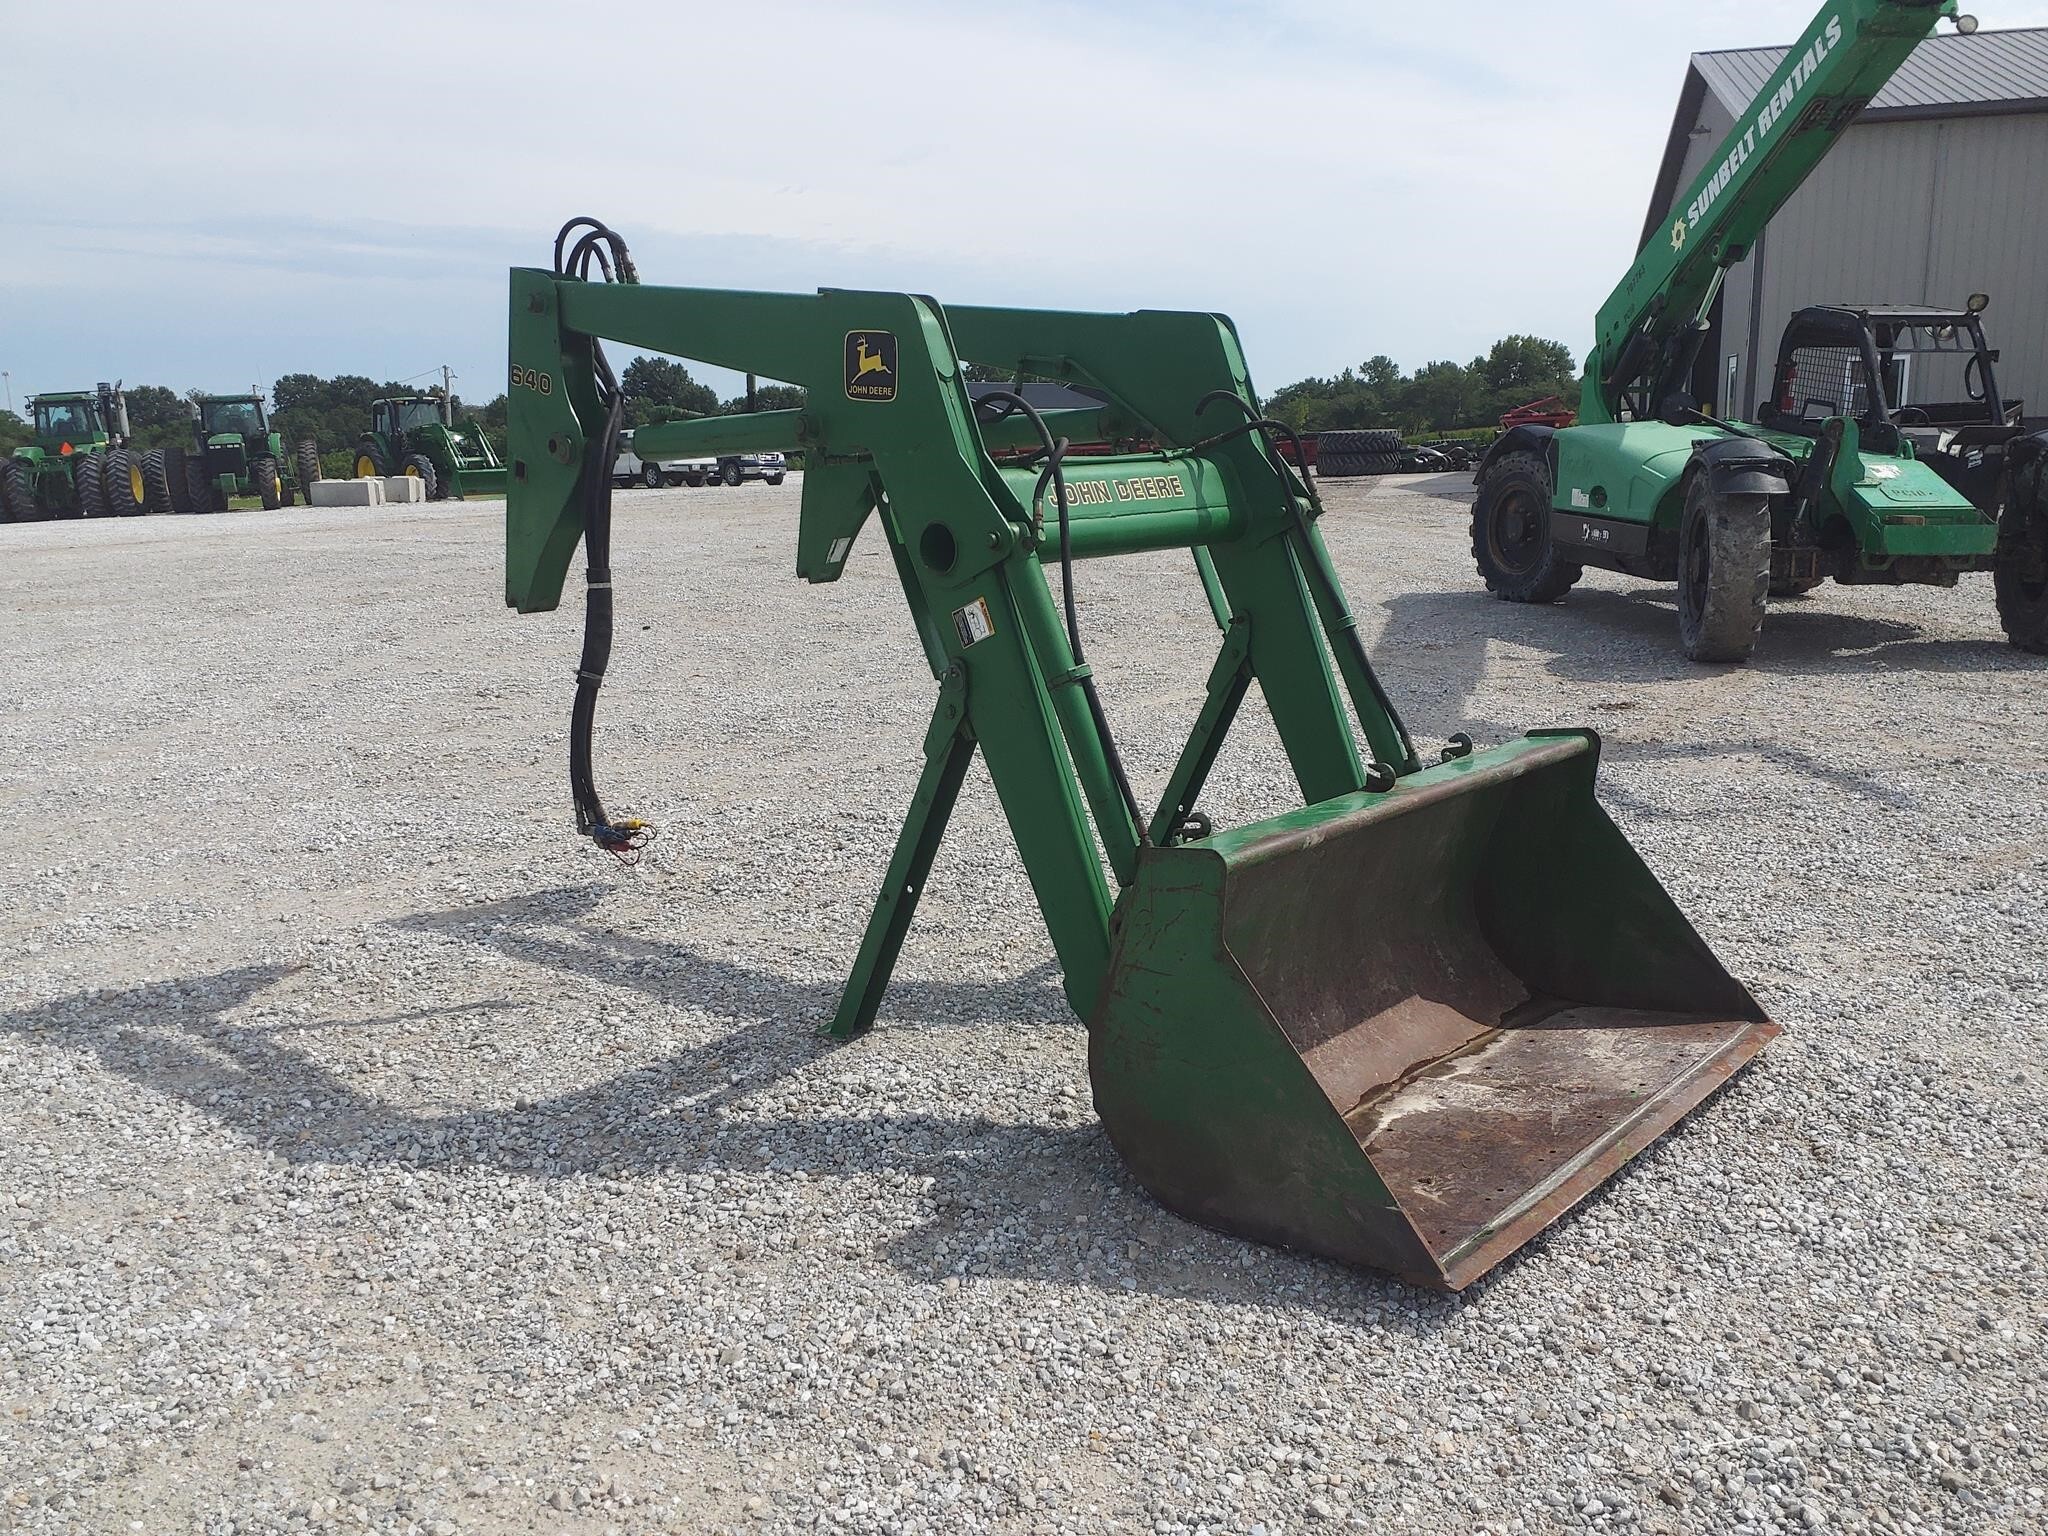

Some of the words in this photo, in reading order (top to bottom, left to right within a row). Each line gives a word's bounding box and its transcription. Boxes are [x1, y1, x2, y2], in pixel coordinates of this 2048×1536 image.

[1687, 125, 1756, 229] SUNBELT
[1757, 14, 1842, 138] RENTALS
[510, 363, 552, 395] 640
[848, 385, 868, 395] JOHN
[869, 386, 893, 395] DEERE
[1112, 475, 1186, 502] DEERE
